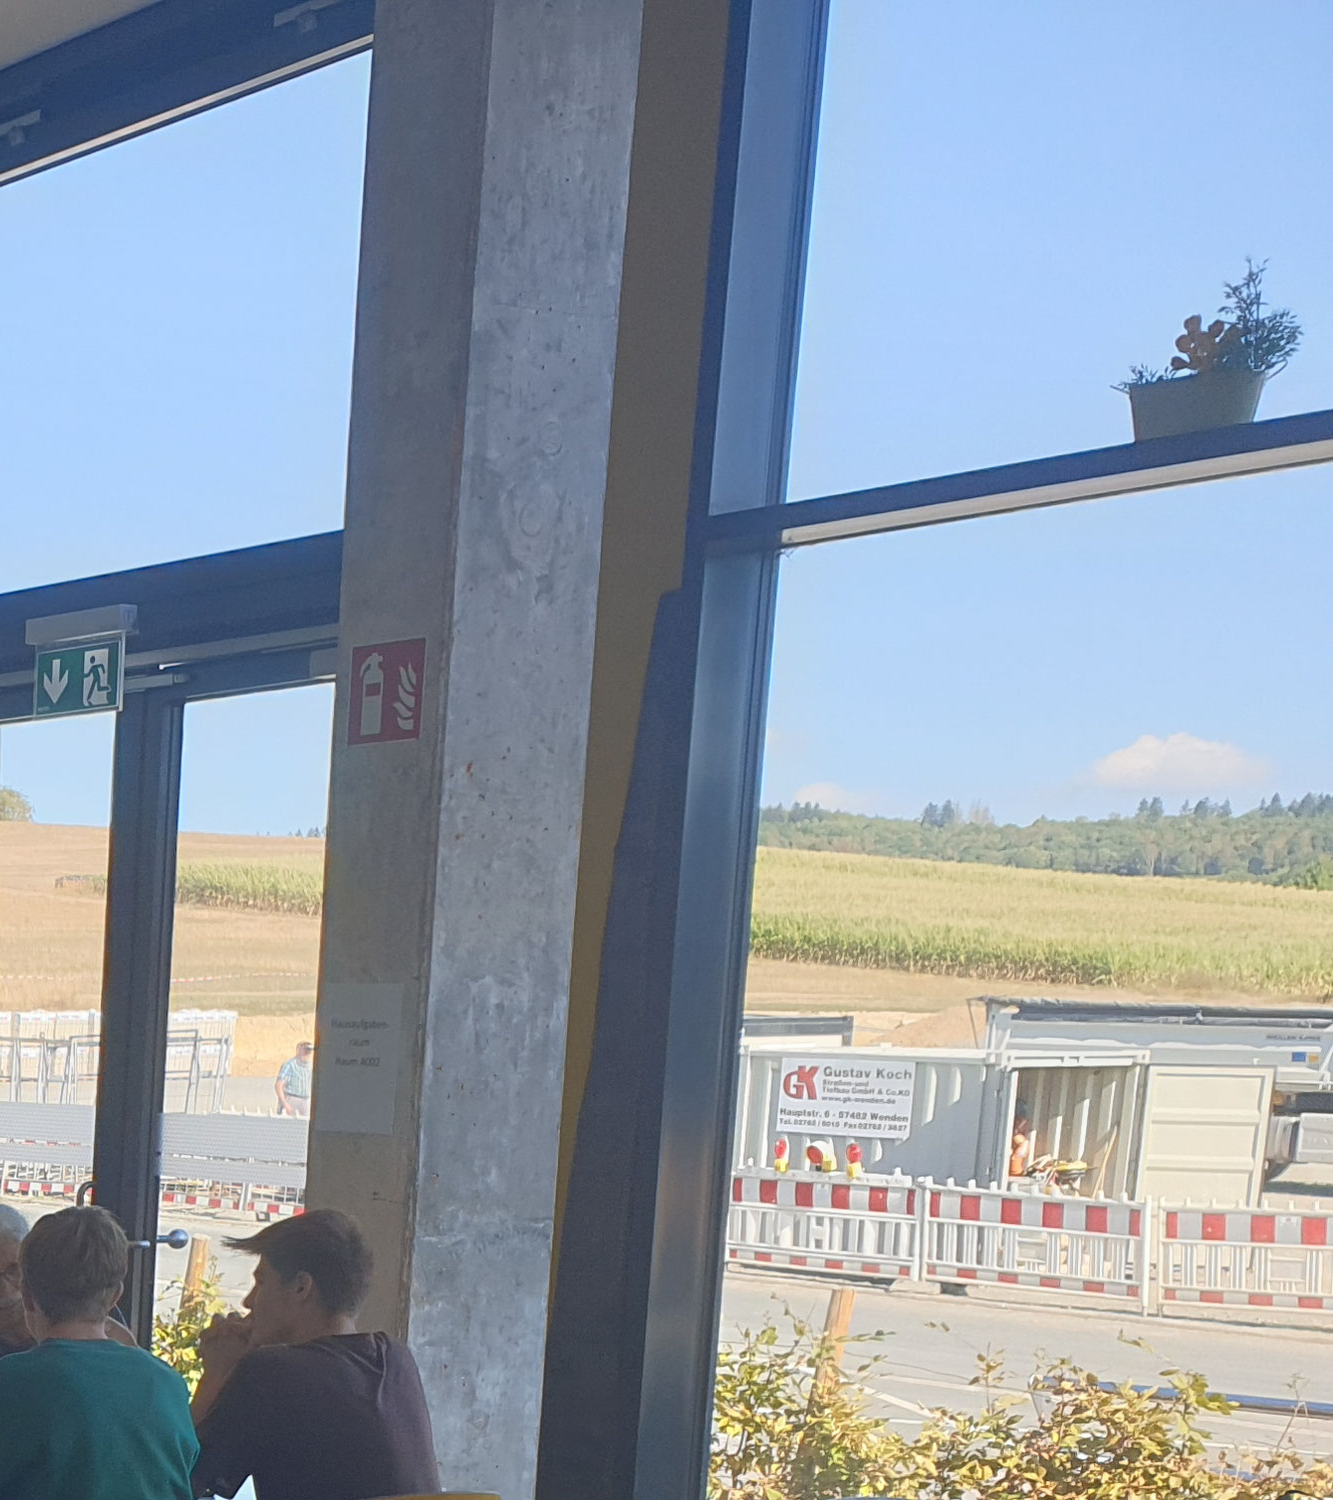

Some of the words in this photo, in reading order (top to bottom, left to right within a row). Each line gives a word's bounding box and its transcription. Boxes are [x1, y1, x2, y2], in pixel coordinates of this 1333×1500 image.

[823, 1066, 871, 1079] Gustav
[876, 1068, 913, 1080] Koch
[851, 1088, 875, 1096] GmbH
[780, 1108, 822, 1118] Hauptstr.
[870, 1112, 909, 1123] Wenden
